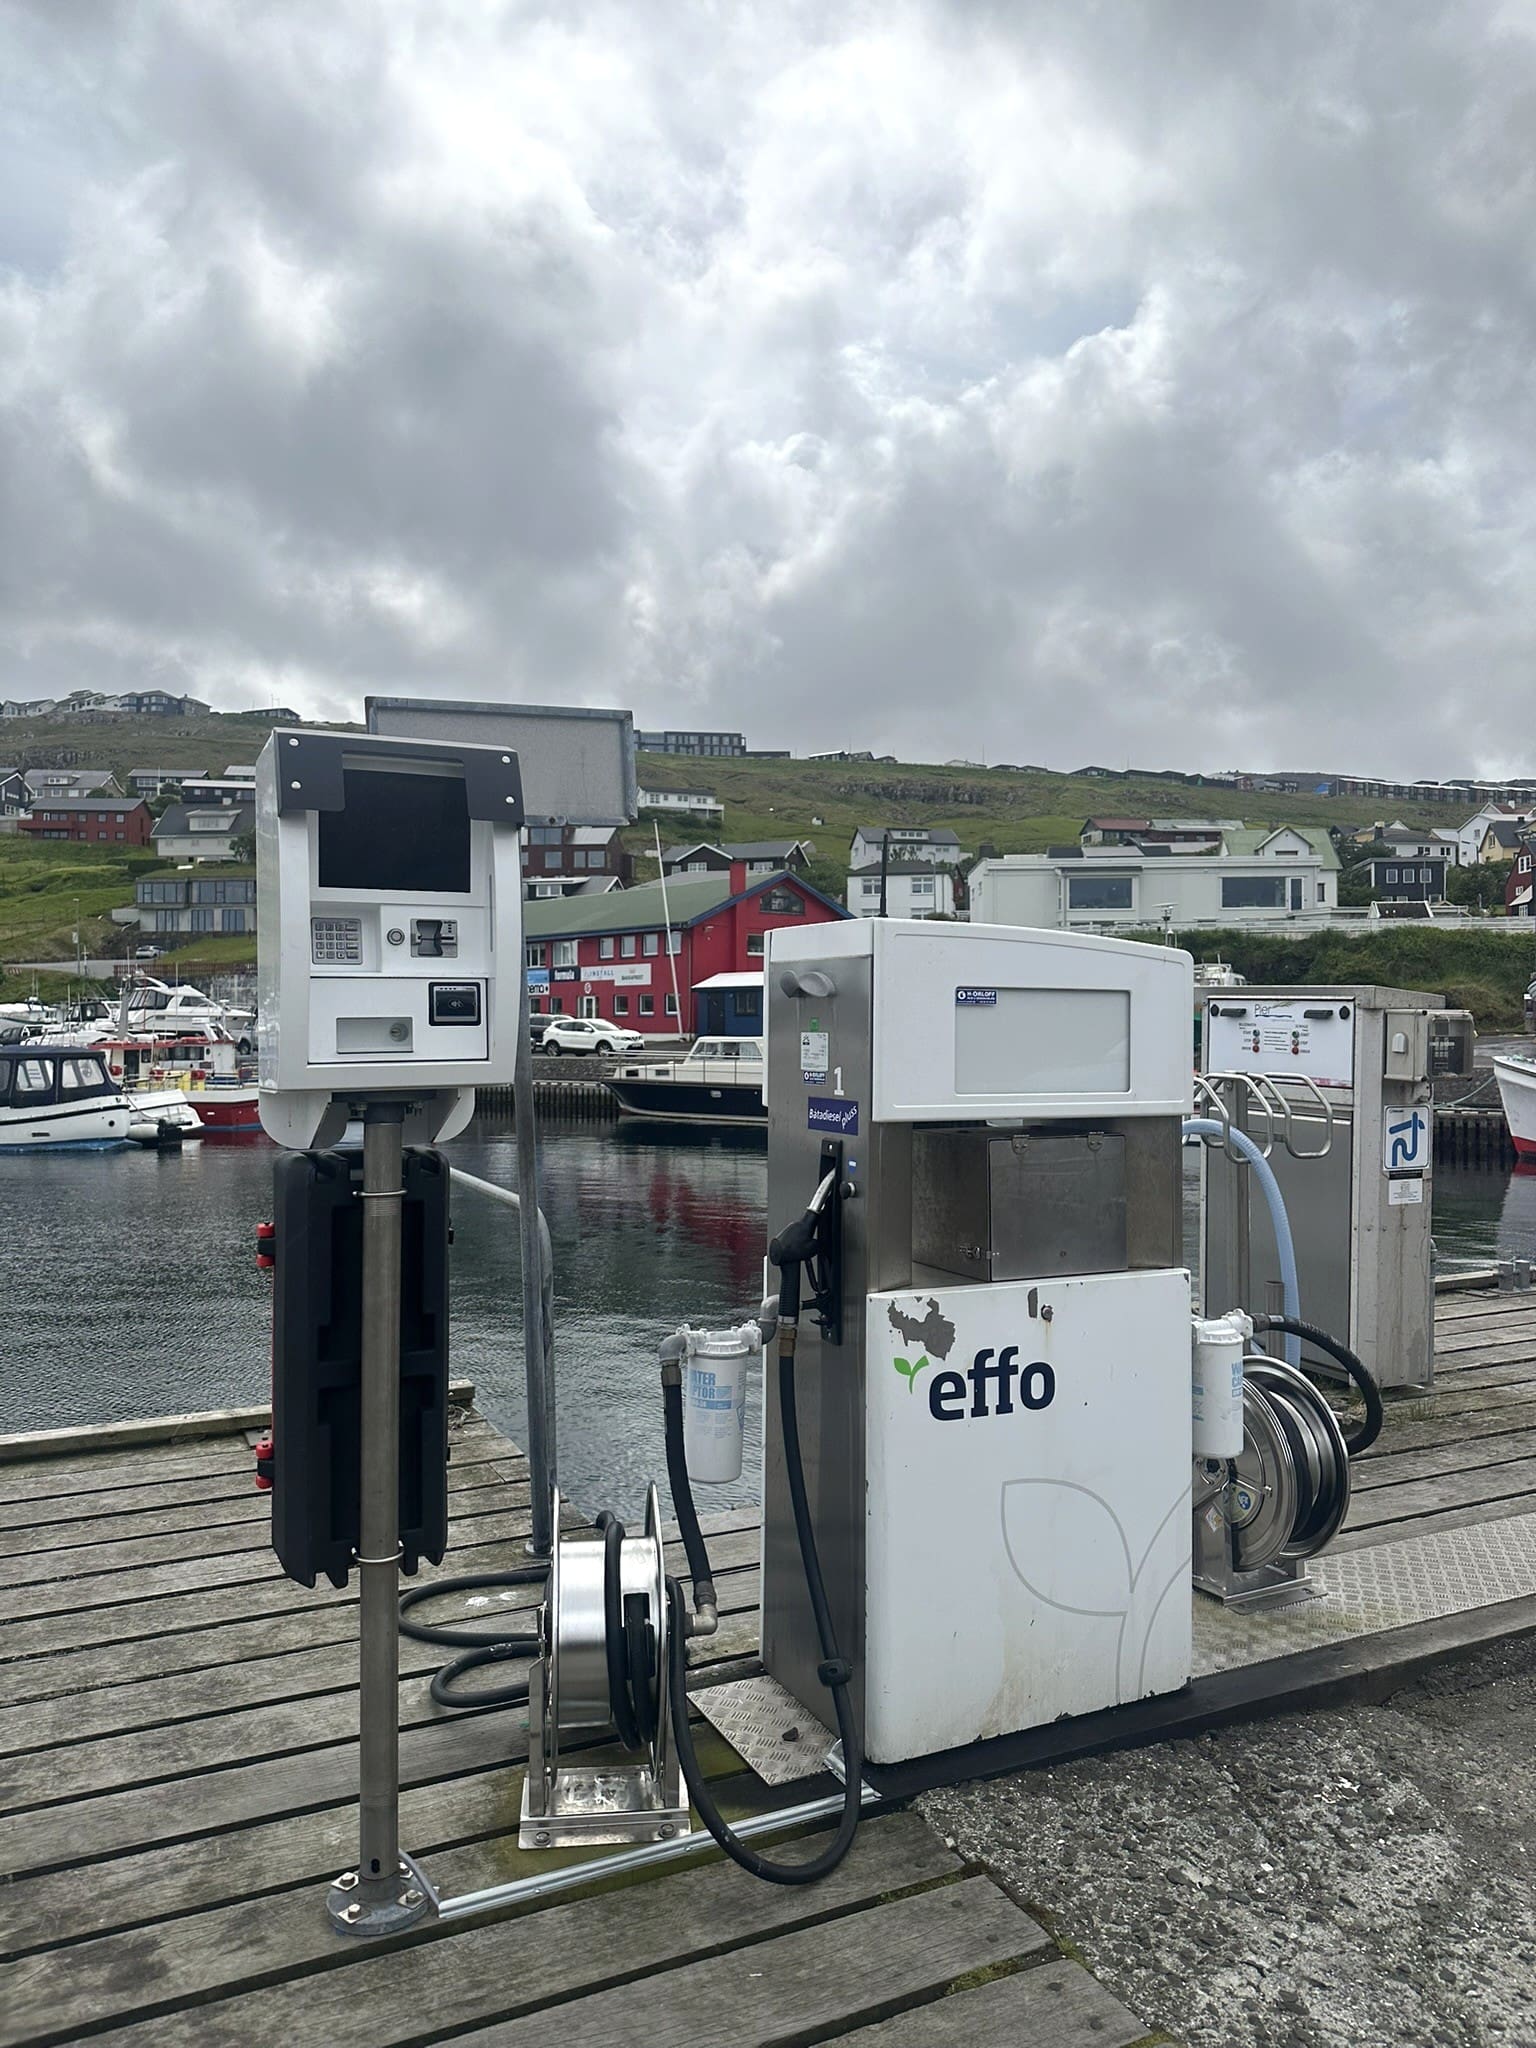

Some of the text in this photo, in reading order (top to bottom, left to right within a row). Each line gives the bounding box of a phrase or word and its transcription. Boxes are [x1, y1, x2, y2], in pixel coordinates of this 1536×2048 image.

[834, 1066, 845, 1096] 1
[842, 1105, 858, 1130] pluss
[690, 1369, 716, 1386] ATER
[929, 1346, 1056, 1421] effo
